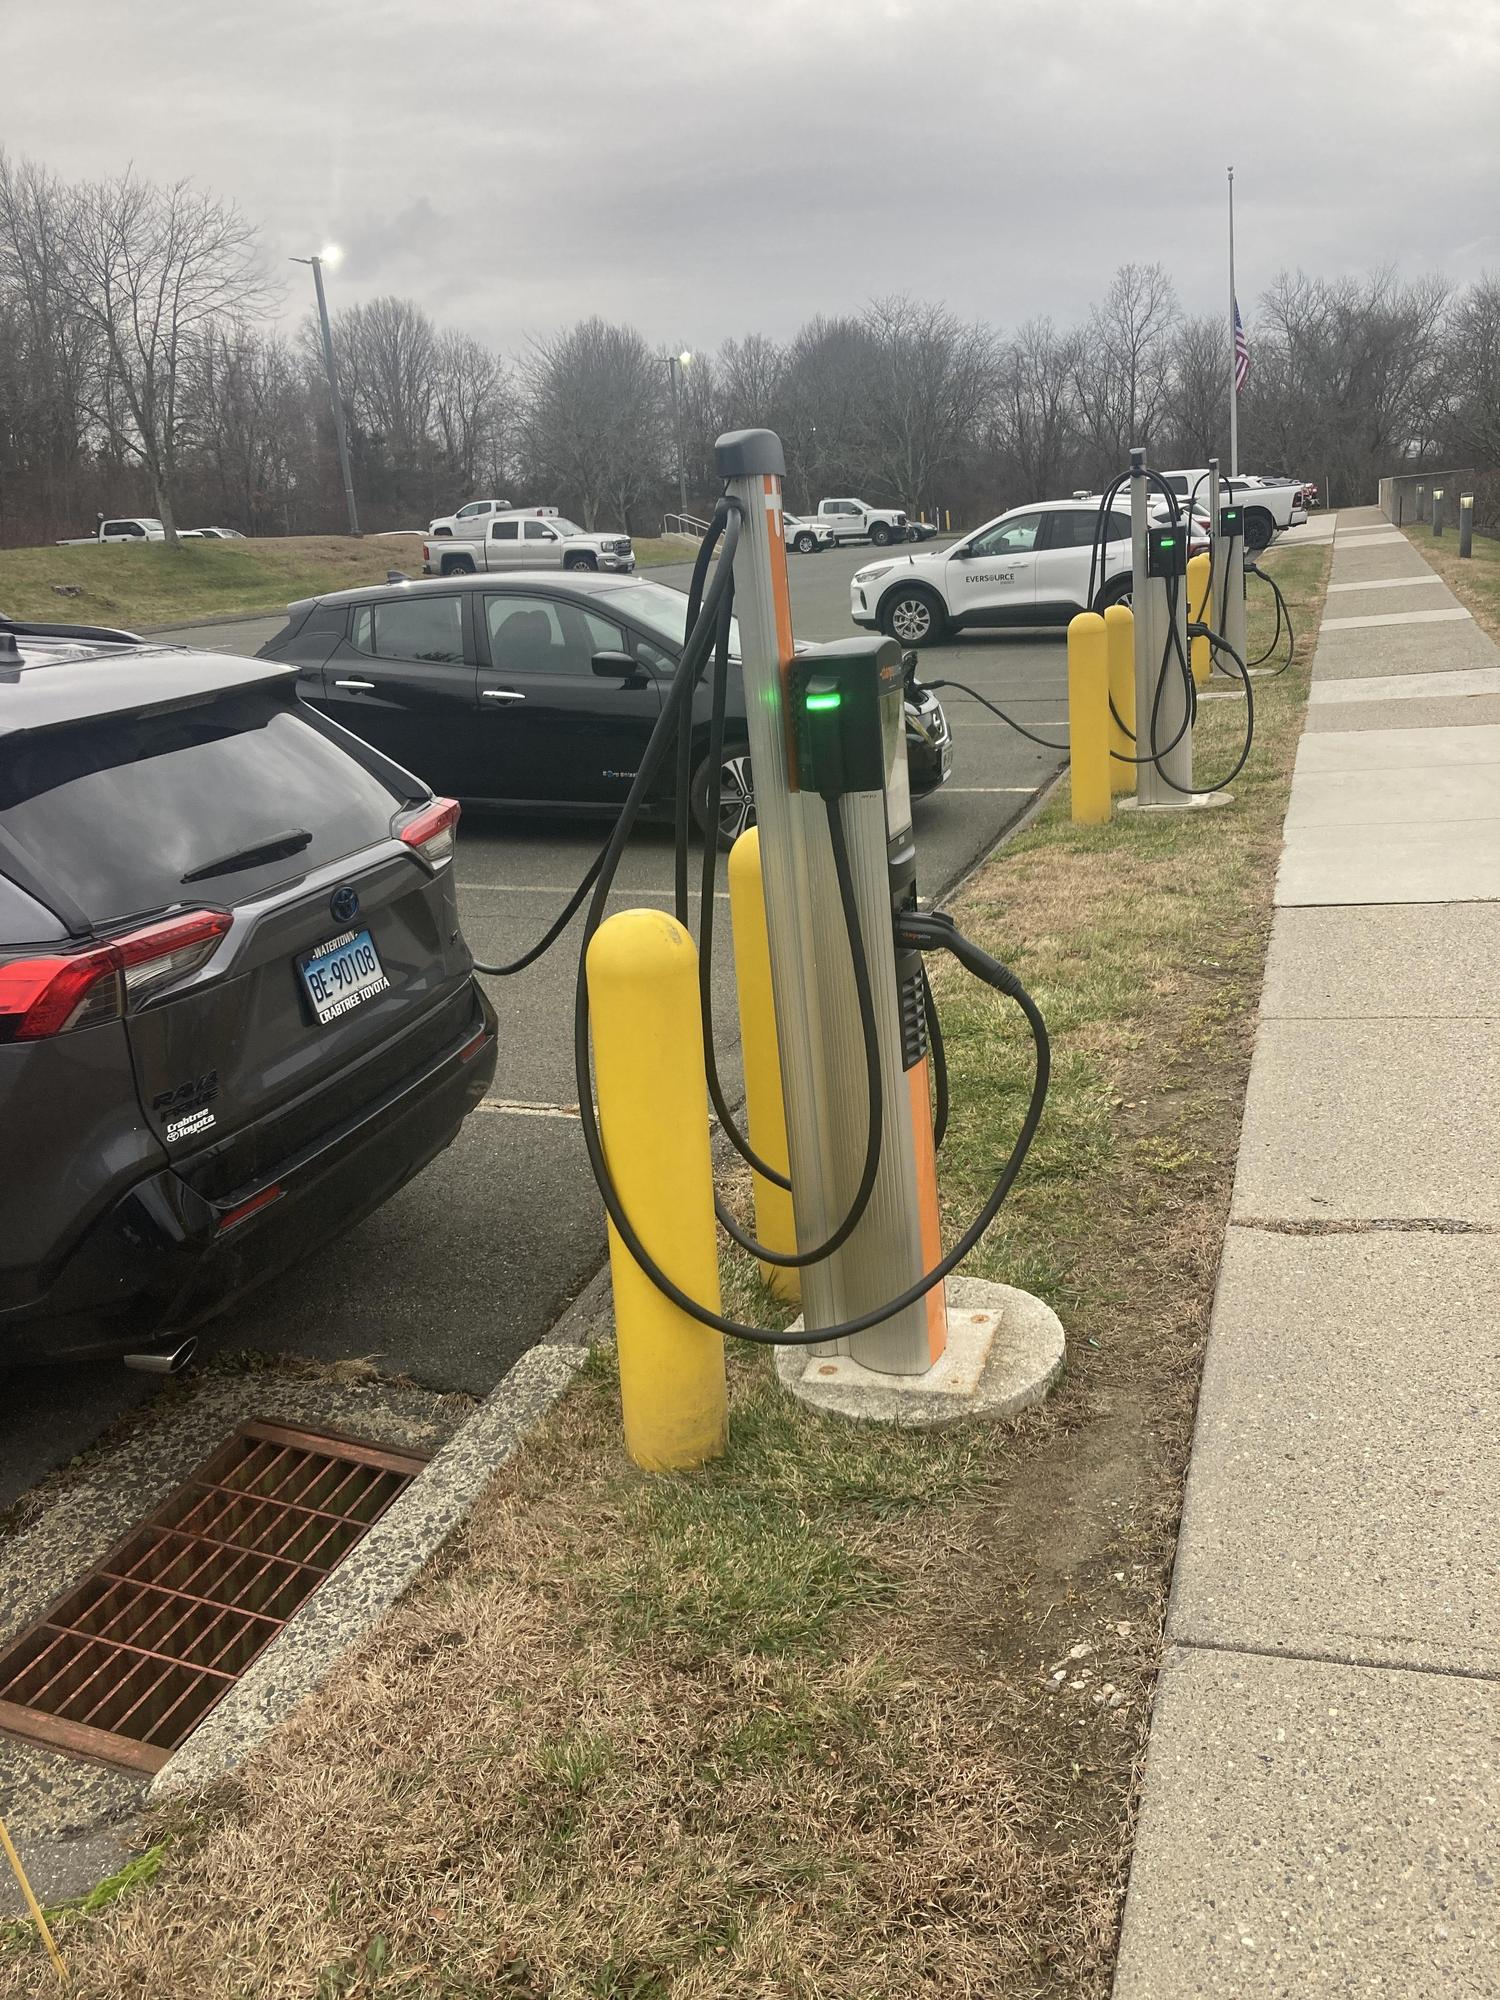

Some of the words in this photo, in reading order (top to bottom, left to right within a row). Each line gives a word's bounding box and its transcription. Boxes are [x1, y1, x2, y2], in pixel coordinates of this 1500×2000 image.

[965, 573, 1015, 583] EVERSOURCE
[319, 993, 362, 1025] CRABTREE
[359, 976, 391, 1002] TOYOTA
[166, 1108, 209, 1133] Crabtree
[178, 1114, 215, 1137] Toyota
